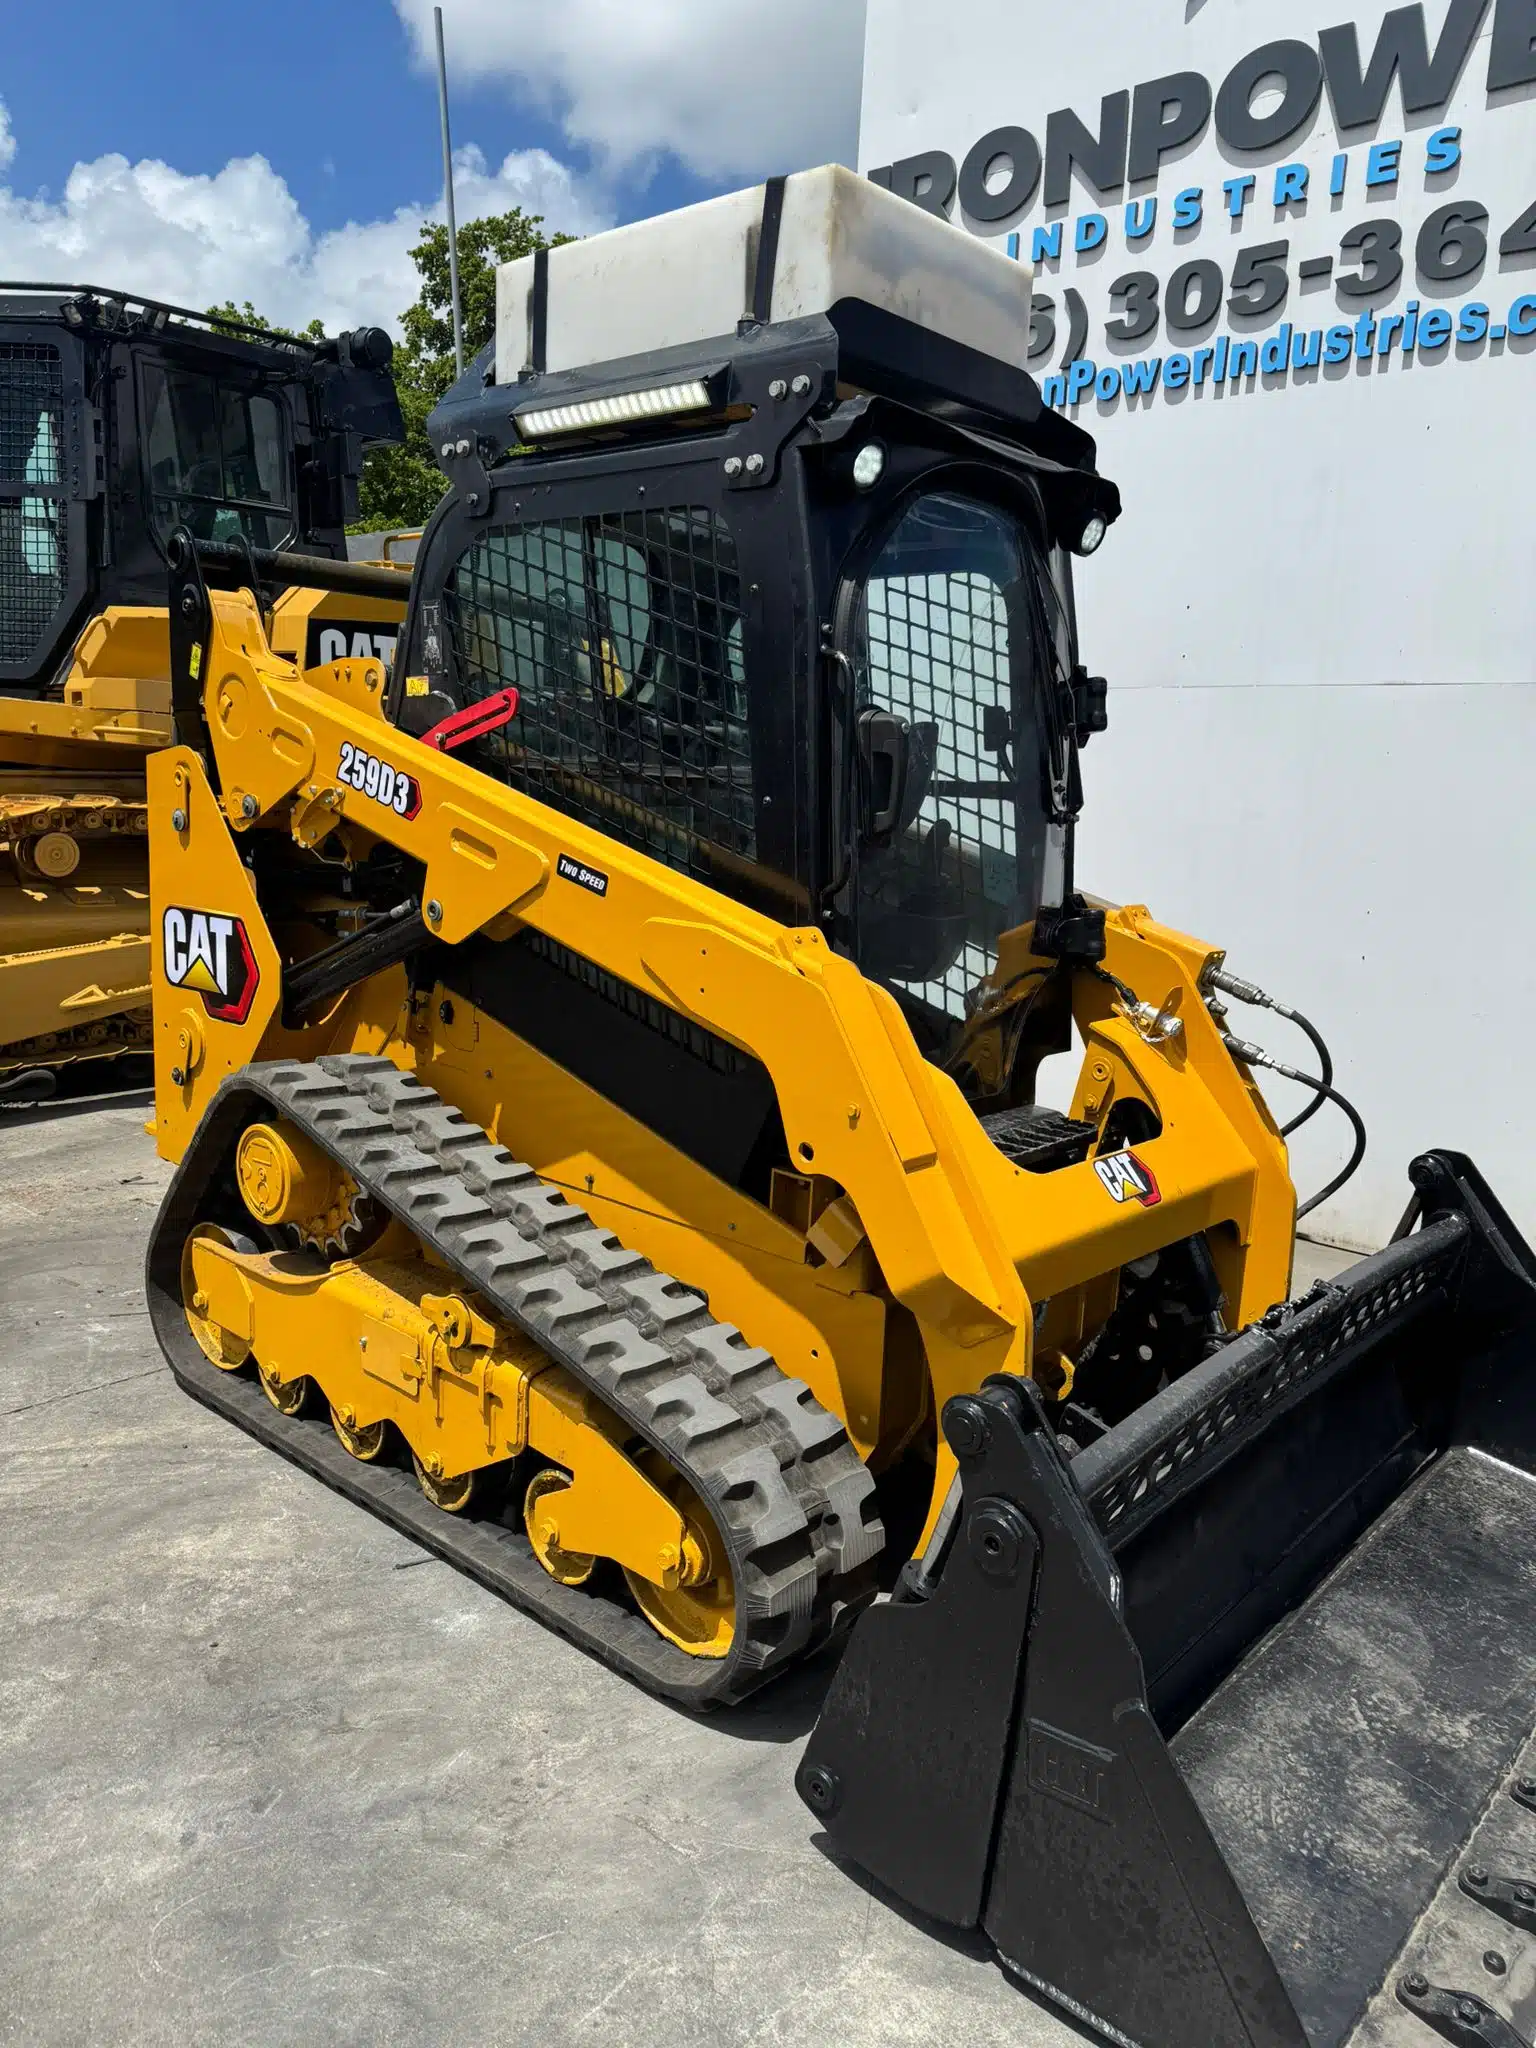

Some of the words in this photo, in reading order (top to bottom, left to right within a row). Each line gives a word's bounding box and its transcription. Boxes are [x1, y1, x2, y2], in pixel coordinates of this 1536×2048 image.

[868, 0, 1536, 222] RONPOW
[1007, 127, 1462, 263] INDUSTRIES
[320, 628, 397, 666] CAT
[337, 742, 410, 815] 259D3
[164, 908, 233, 996] CAT
[1094, 1153, 1148, 1202] CAT
